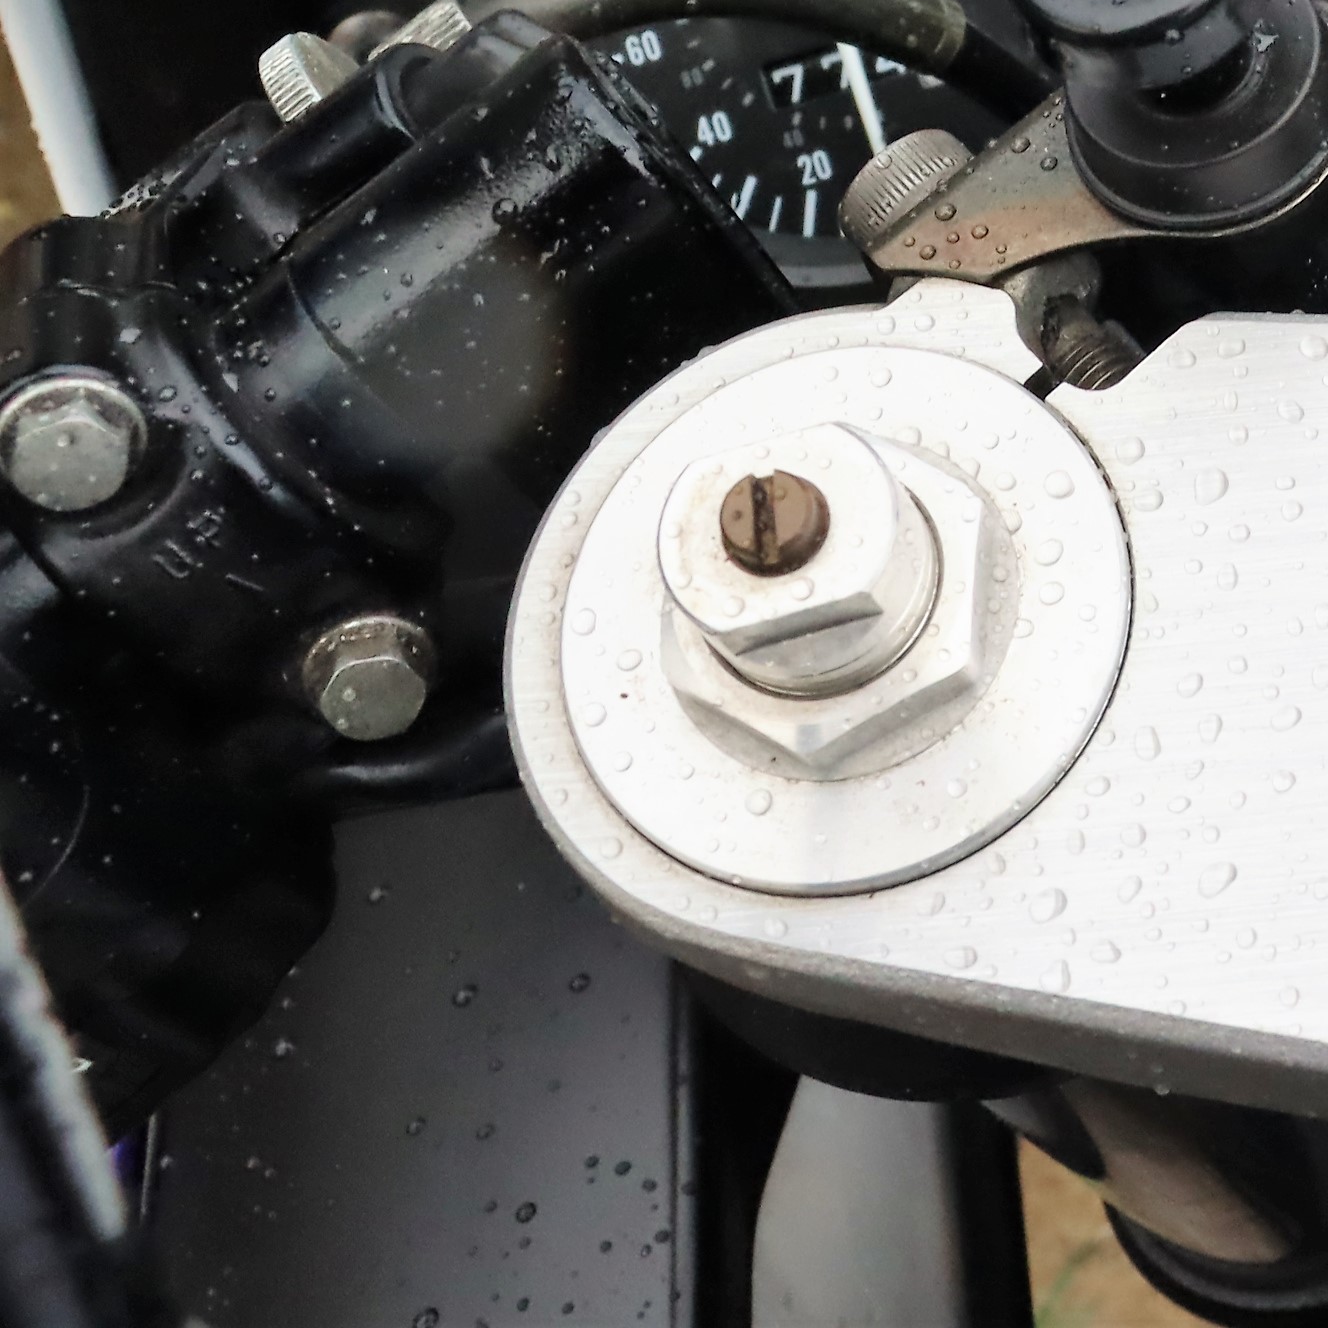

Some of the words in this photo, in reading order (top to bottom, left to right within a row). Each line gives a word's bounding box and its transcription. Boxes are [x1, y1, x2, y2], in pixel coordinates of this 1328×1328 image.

[624, 29, 663, 68] 60
[696, 109, 734, 147] 40
[796, 149, 833, 187] 20
